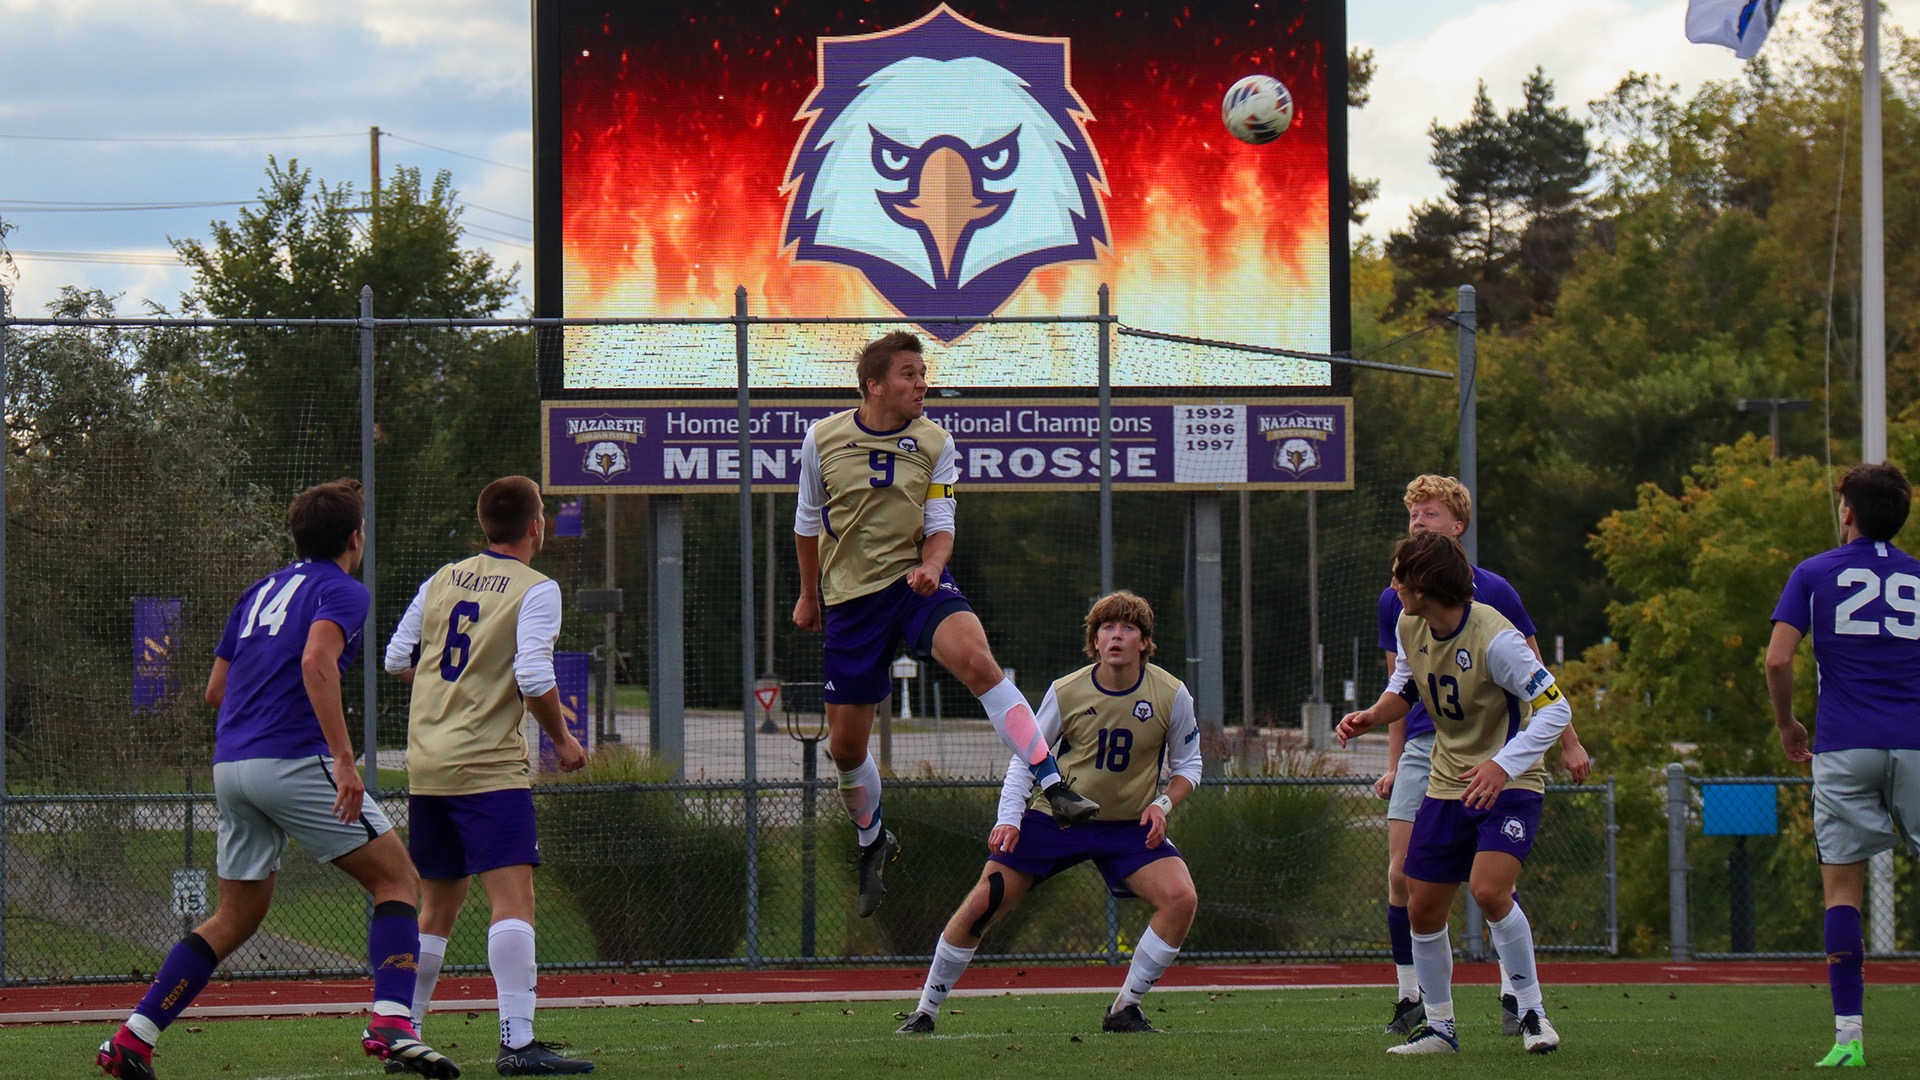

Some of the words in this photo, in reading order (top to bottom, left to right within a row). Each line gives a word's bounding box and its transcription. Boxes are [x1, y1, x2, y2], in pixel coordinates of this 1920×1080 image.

[568, 419, 644, 435] NAZARETH
[667, 412, 739, 434] Home
[749, 411, 771, 434] of
[923, 410, 1011, 433] tional
[1017, 410, 1152, 437] Champons
[1186, 408, 1234, 419] 1992
[1260, 416, 1334, 432] NAZARETH
[1186, 424, 1235, 435] 1996
[1186, 440, 1234, 451] 1997
[663, 447, 802, 479] MEN'
[953, 447, 1157, 478] ROSSE
[869, 450, 896, 488] 9
[448, 569, 511, 593] NAZARETH
[240, 574, 306, 638] 14
[1835, 567, 1920, 640] 29
[440, 600, 480, 682] 6
[1427, 672, 1465, 721] 13
[1095, 727, 1134, 773] 18
[179, 894, 201, 911] 15
